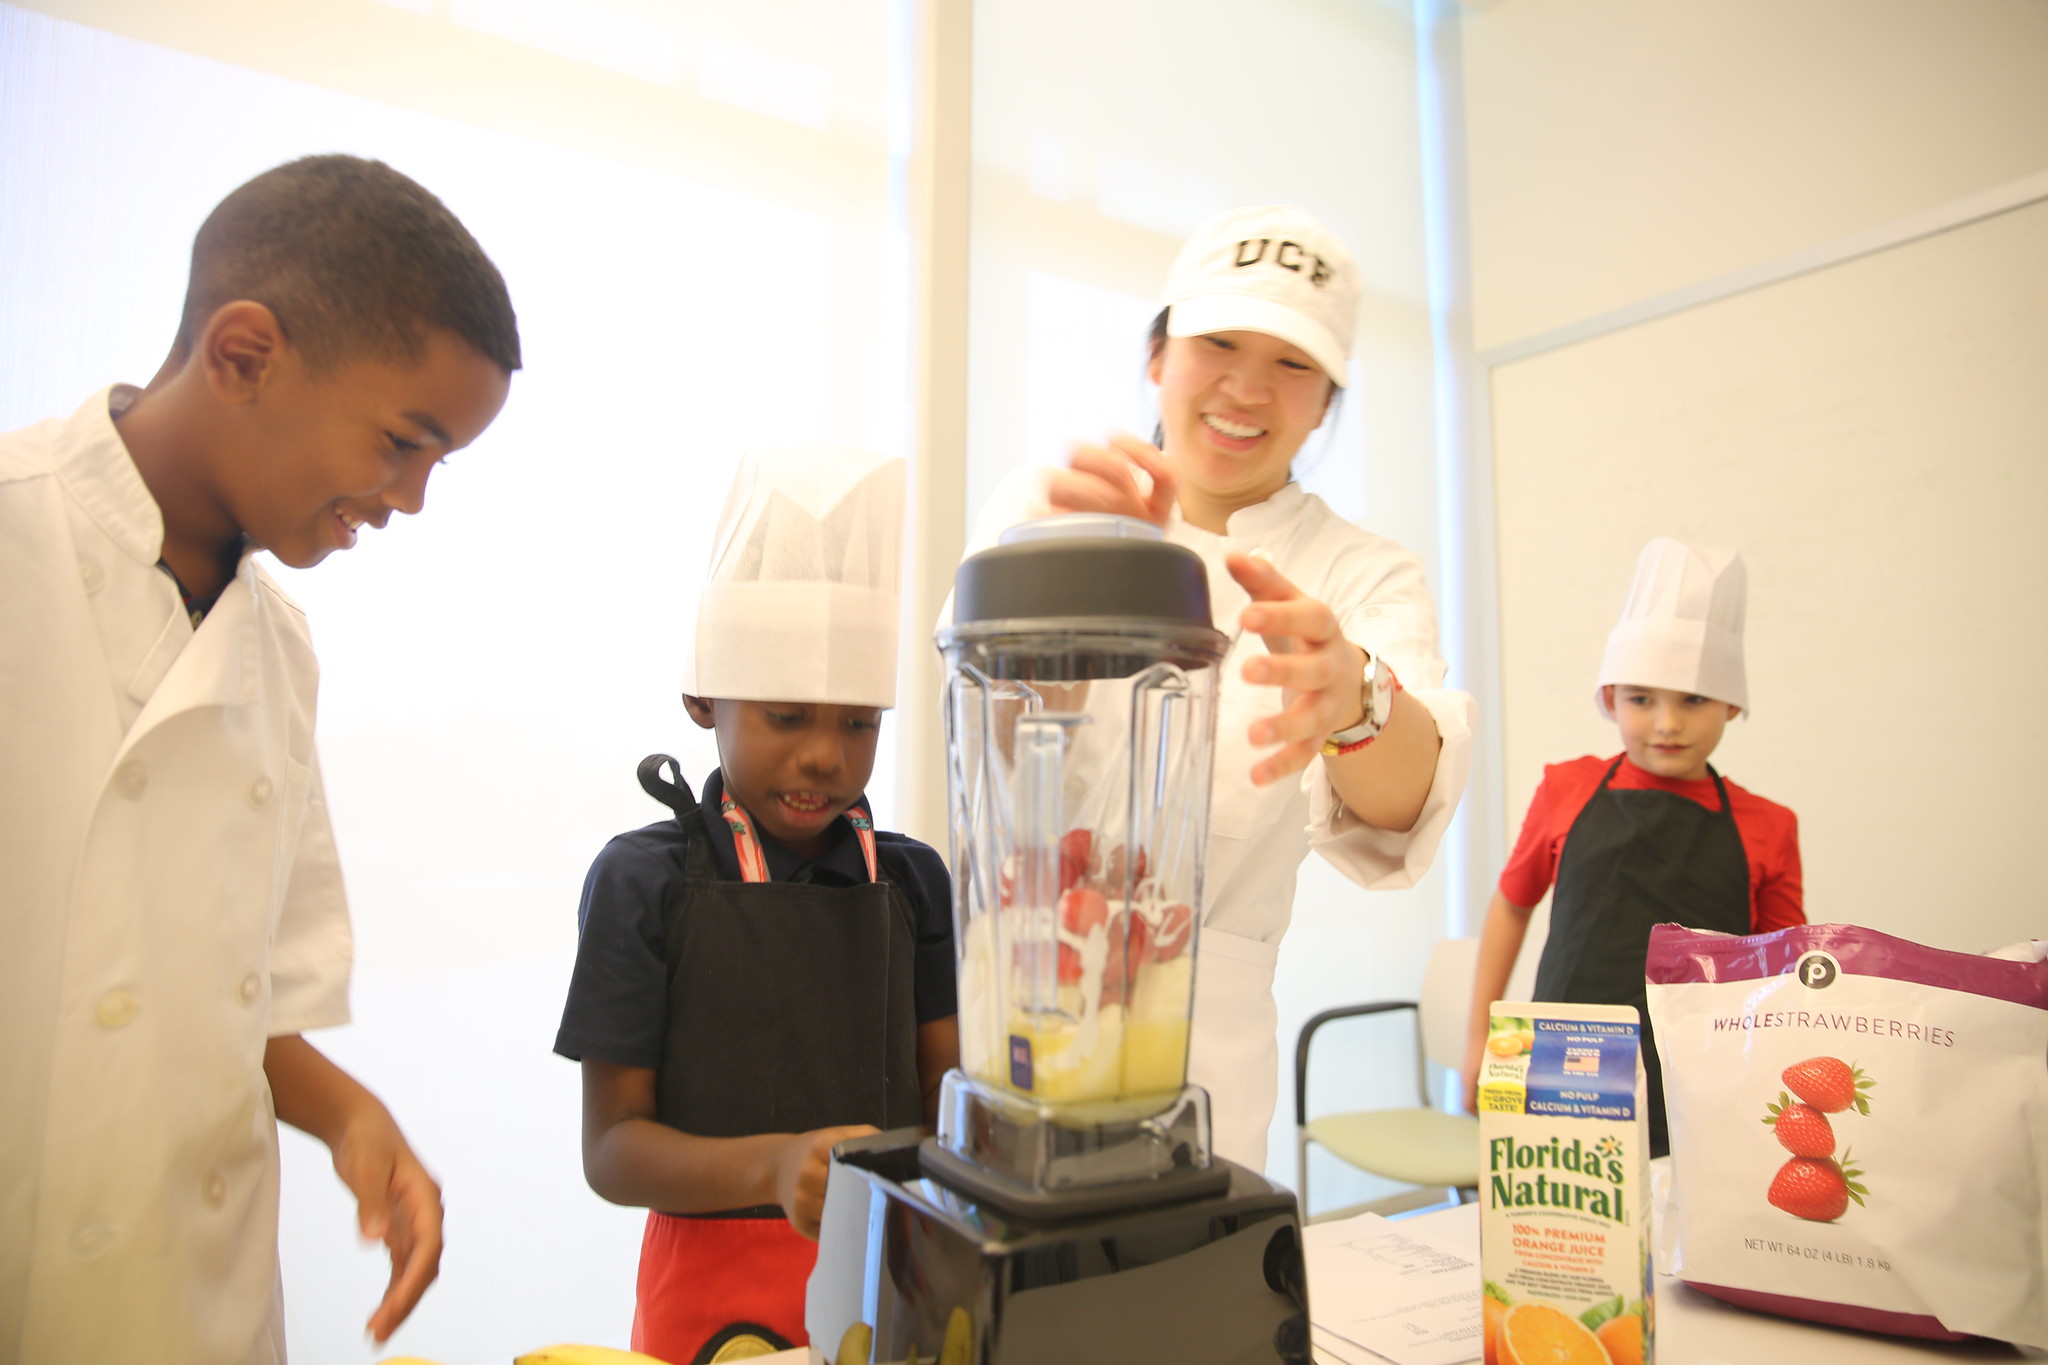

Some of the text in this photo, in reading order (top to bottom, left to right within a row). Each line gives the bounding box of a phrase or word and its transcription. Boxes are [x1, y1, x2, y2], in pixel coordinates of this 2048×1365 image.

[1538, 1021, 1634, 1035] CALCIUM & VITAMIN D
[1582, 1036, 1605, 1044] PULP
[1560, 1090, 1600, 1102] NO PULP
[1529, 1100, 1631, 1117] CALCIUM & VITAMIN D
[1490, 1135, 1625, 1185] Florida's
[1491, 1173, 1625, 1225] Natural
[1512, 1223, 1607, 1244] 100% PREMIUM
[1512, 1237, 1605, 1257] ORANGE JUICE
[1744, 1237, 1765, 1251] NET
[1767, 1240, 1784, 1254] WT
[1787, 1244, 1801, 1257] 64
[1803, 1248, 1819, 1260] OZ
[1822, 1250, 1832, 1263] (4
[1836, 1252, 1853, 1266] LB)
[1856, 1256, 1875, 1270] 1.8
[1560, 1263, 1589, 1273] VITAMIN
